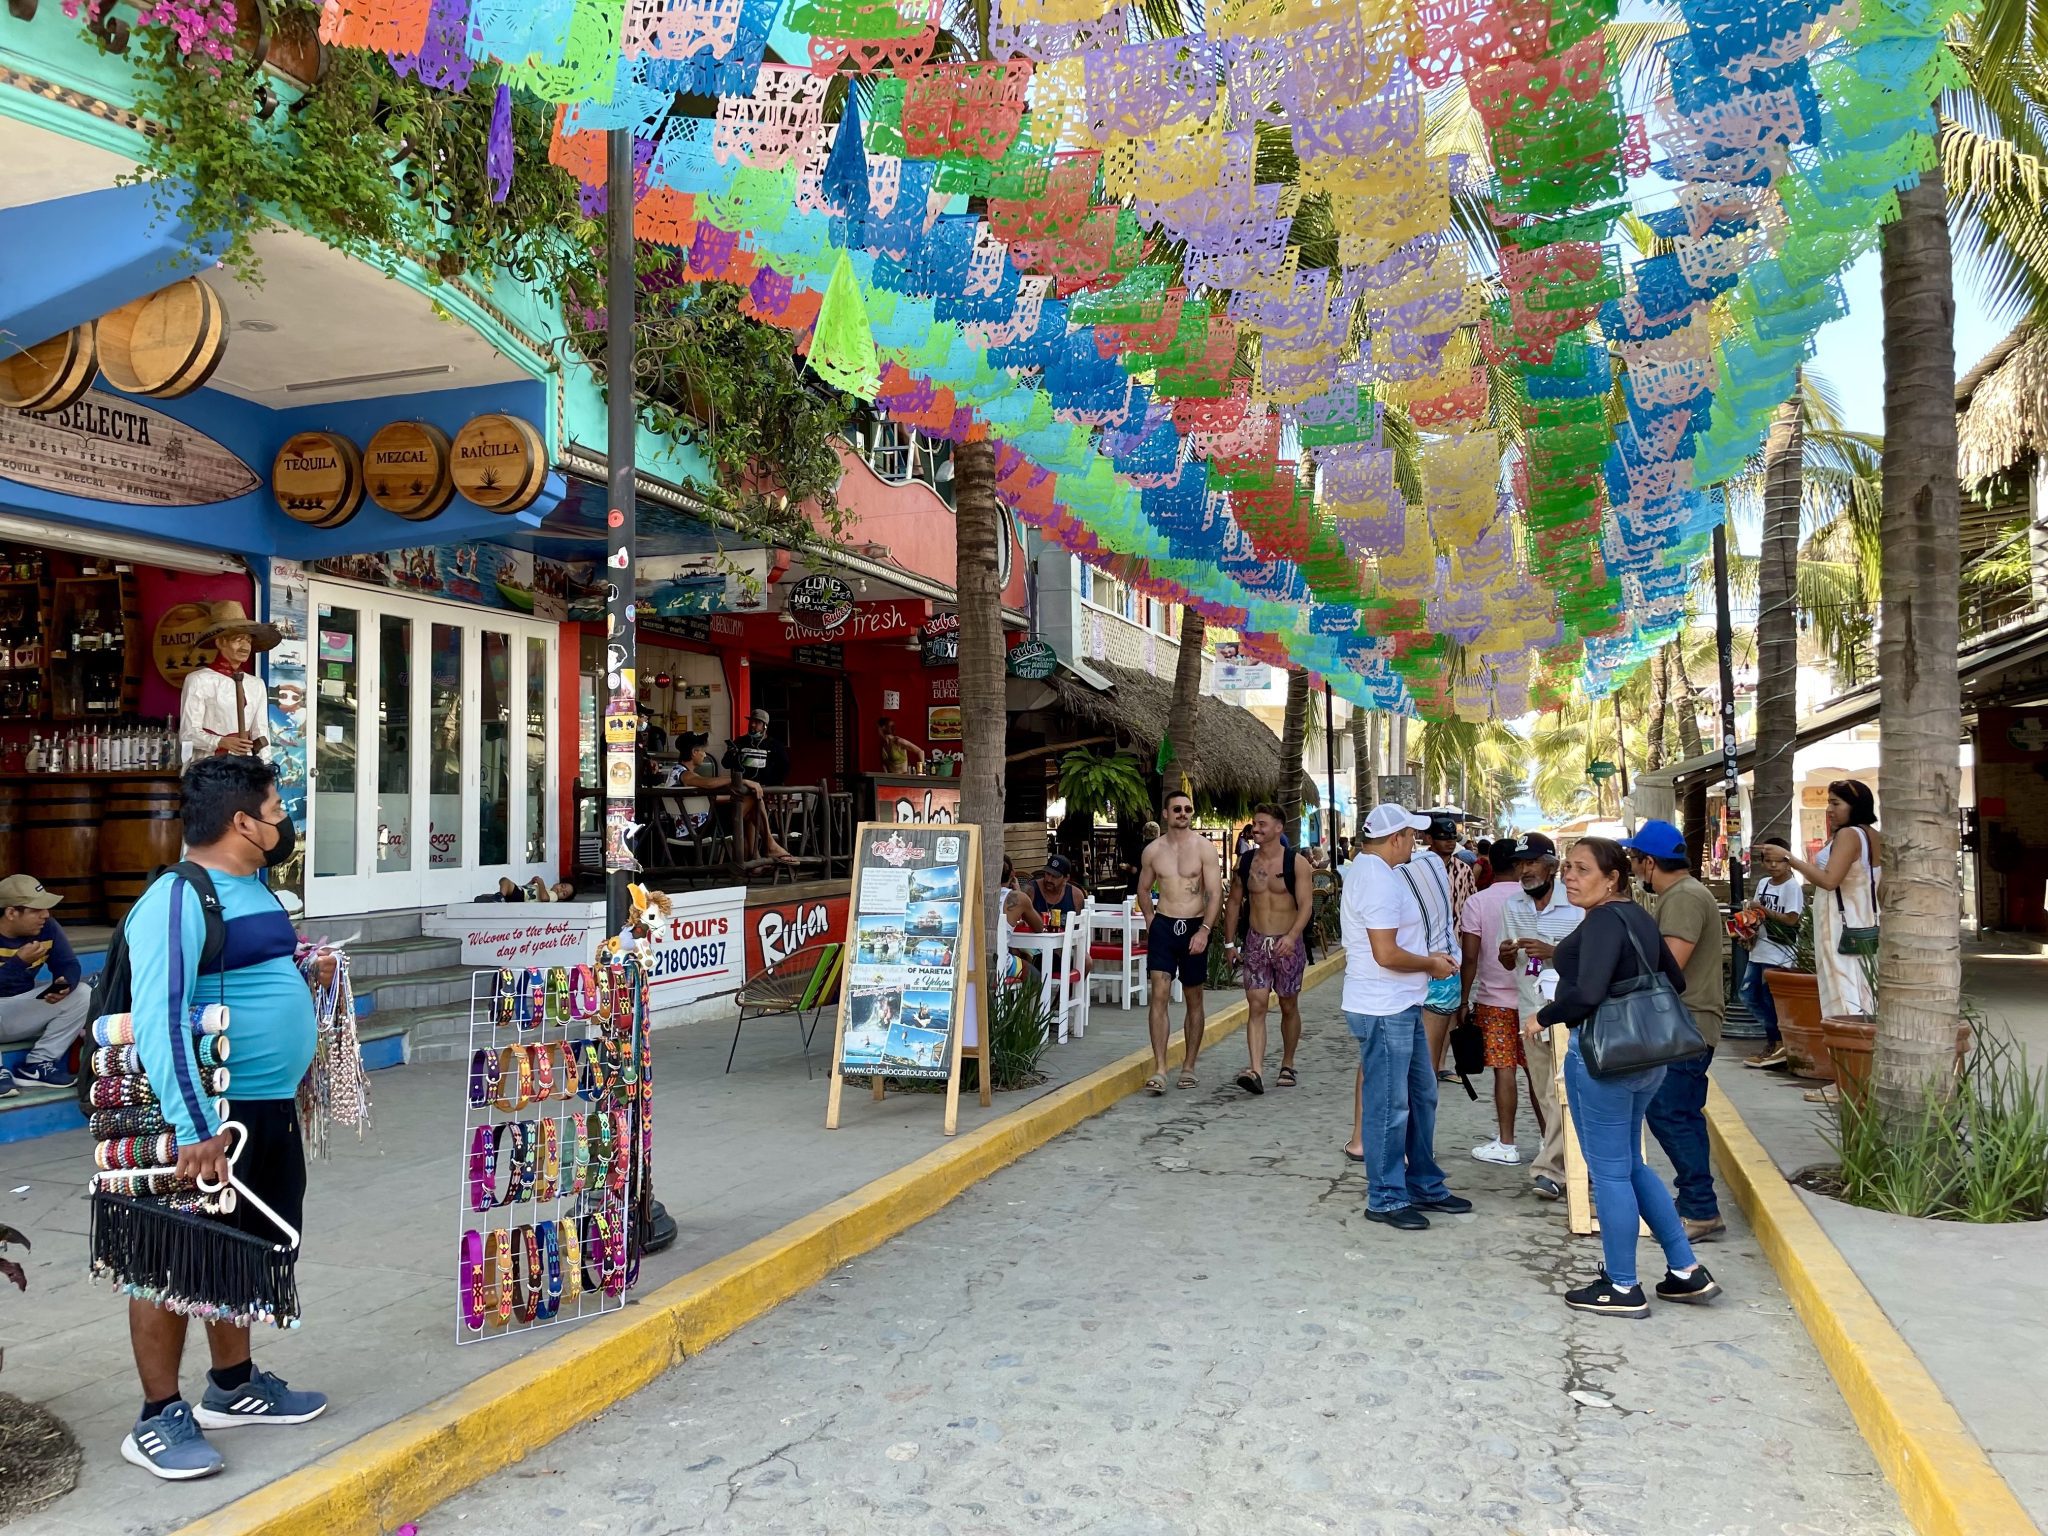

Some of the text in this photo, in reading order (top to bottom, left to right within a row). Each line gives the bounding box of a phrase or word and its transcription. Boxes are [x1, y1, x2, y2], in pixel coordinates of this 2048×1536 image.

[721, 101, 822, 127] SAYULITA
[59, 401, 151, 447] SELECTA
[28, 439, 68, 456] BEST
[80, 451, 178, 479] SELECTIONS
[376, 450, 428, 464] MEZCAL
[461, 443, 520, 459] RAICILLA
[284, 456, 338, 472] TEQUILA
[63, 471, 106, 488] MEZCAL
[126, 484, 172, 501] RAICILLA
[794, 594, 811, 604] NO
[1009, 640, 1046, 661] Ruben
[933, 688, 960, 699] BURGE
[938, 678, 960, 689] CLASS
[932, 748, 963, 763] Ruen
[468, 920, 569, 946] Welcome to the best
[670, 916, 729, 941] tours
[757, 903, 829, 974] Ruben
[496, 931, 584, 960] day of your life!
[647, 941, 727, 977] 21800597
[843, 1065, 948, 1078] www.chicaloccatours.com
